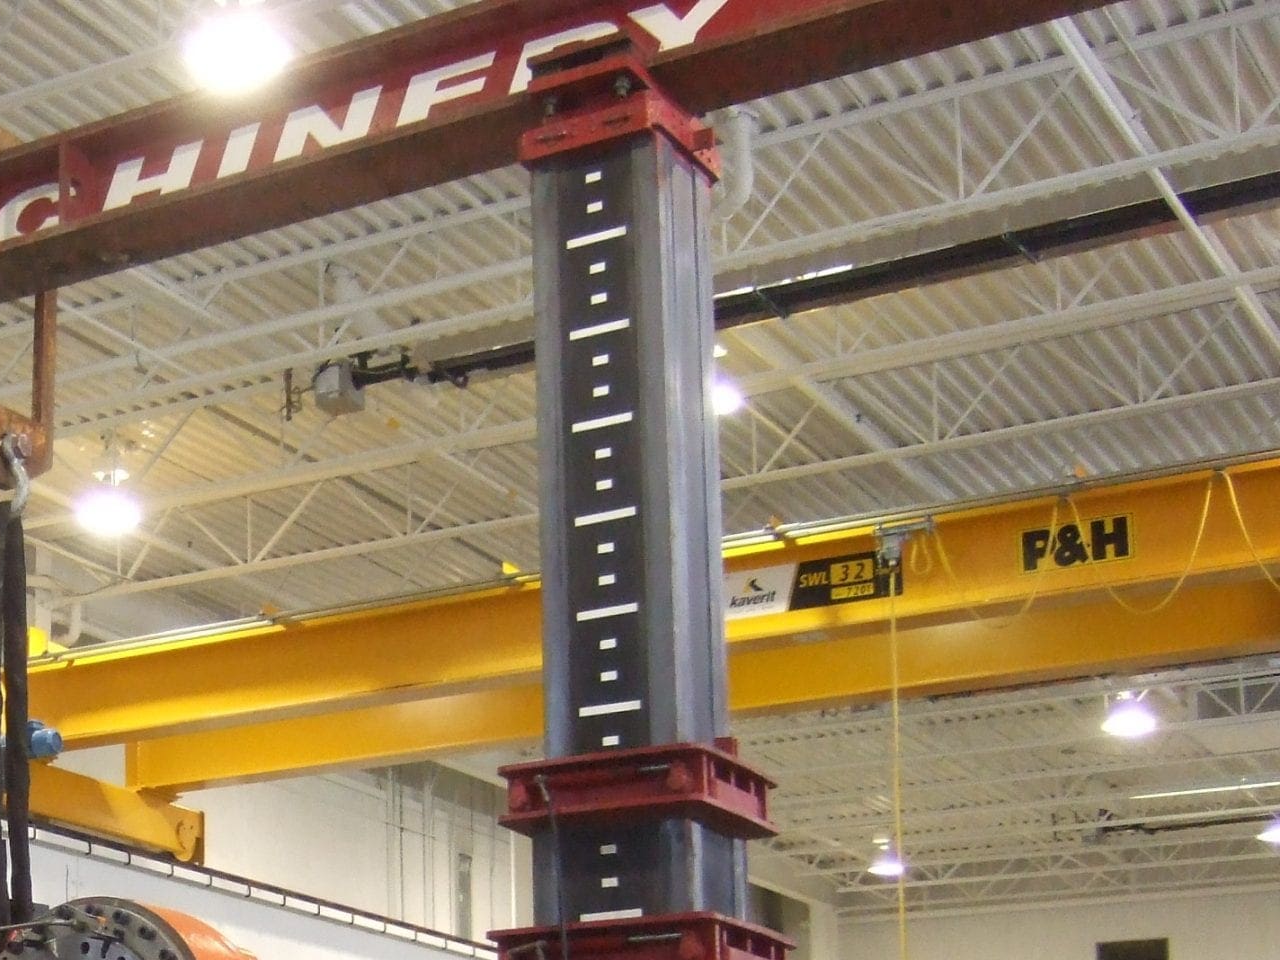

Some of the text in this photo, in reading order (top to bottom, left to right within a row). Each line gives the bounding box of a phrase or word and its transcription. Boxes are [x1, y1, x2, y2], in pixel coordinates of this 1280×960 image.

[1022, 516, 1129, 571] P&H
[799, 571, 829, 588] SWL
[729, 590, 776, 608] kaverit
